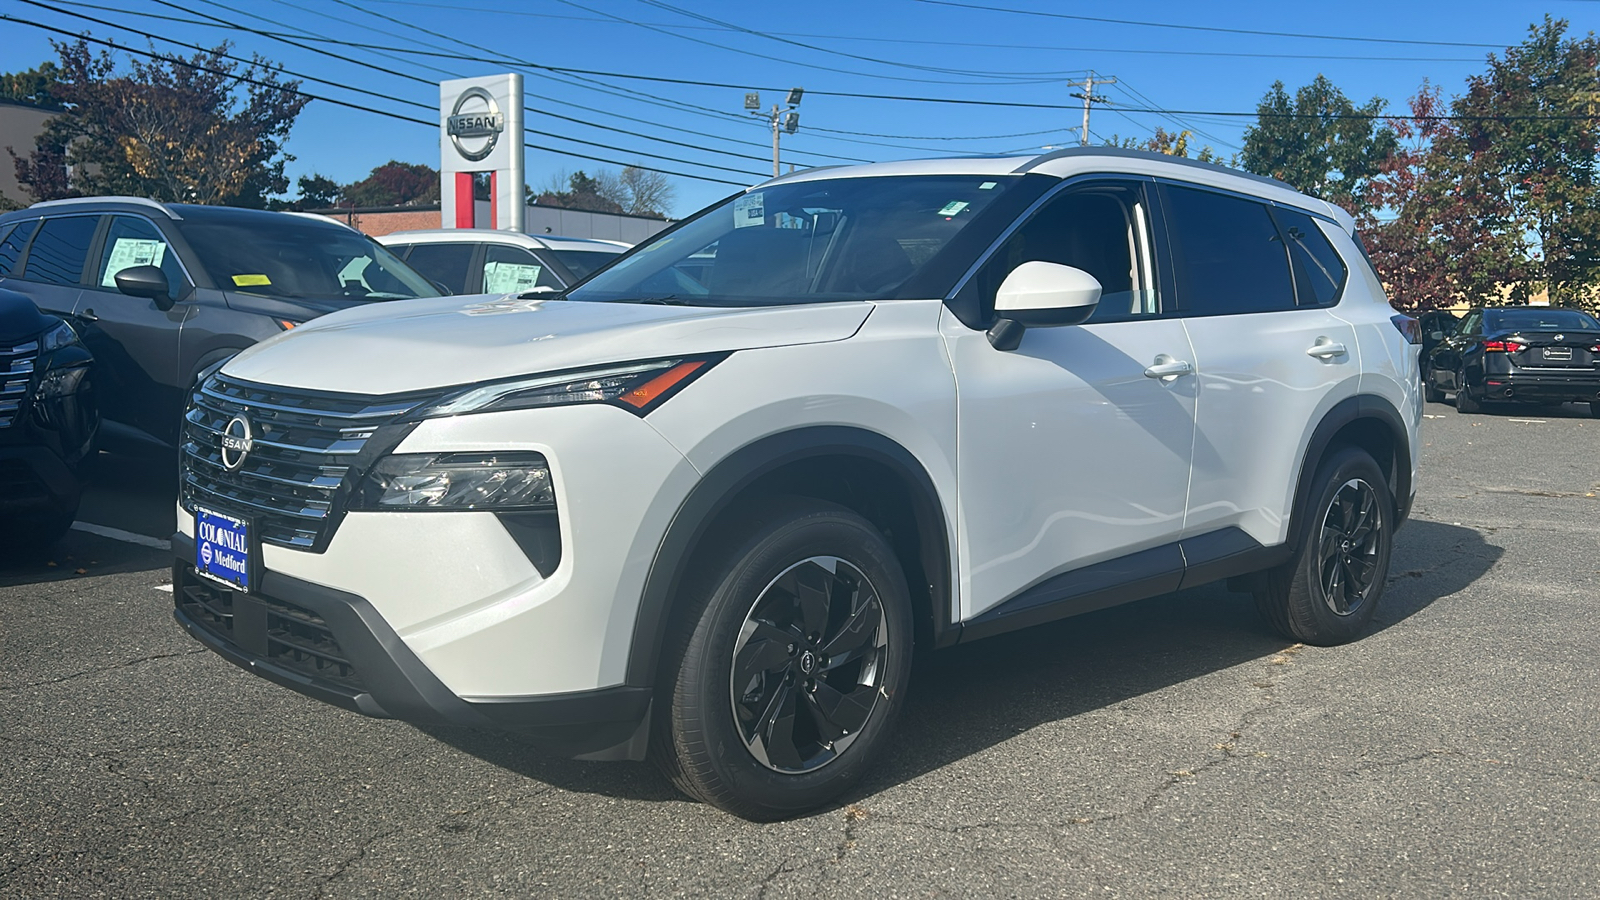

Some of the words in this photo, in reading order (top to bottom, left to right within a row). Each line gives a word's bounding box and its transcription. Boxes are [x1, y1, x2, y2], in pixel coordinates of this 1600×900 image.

[449, 116, 495, 131] NISSAN
[223, 437, 250, 451] SSAN
[199, 521, 248, 554] COLONIAL
[214, 549, 246, 574] Medford
